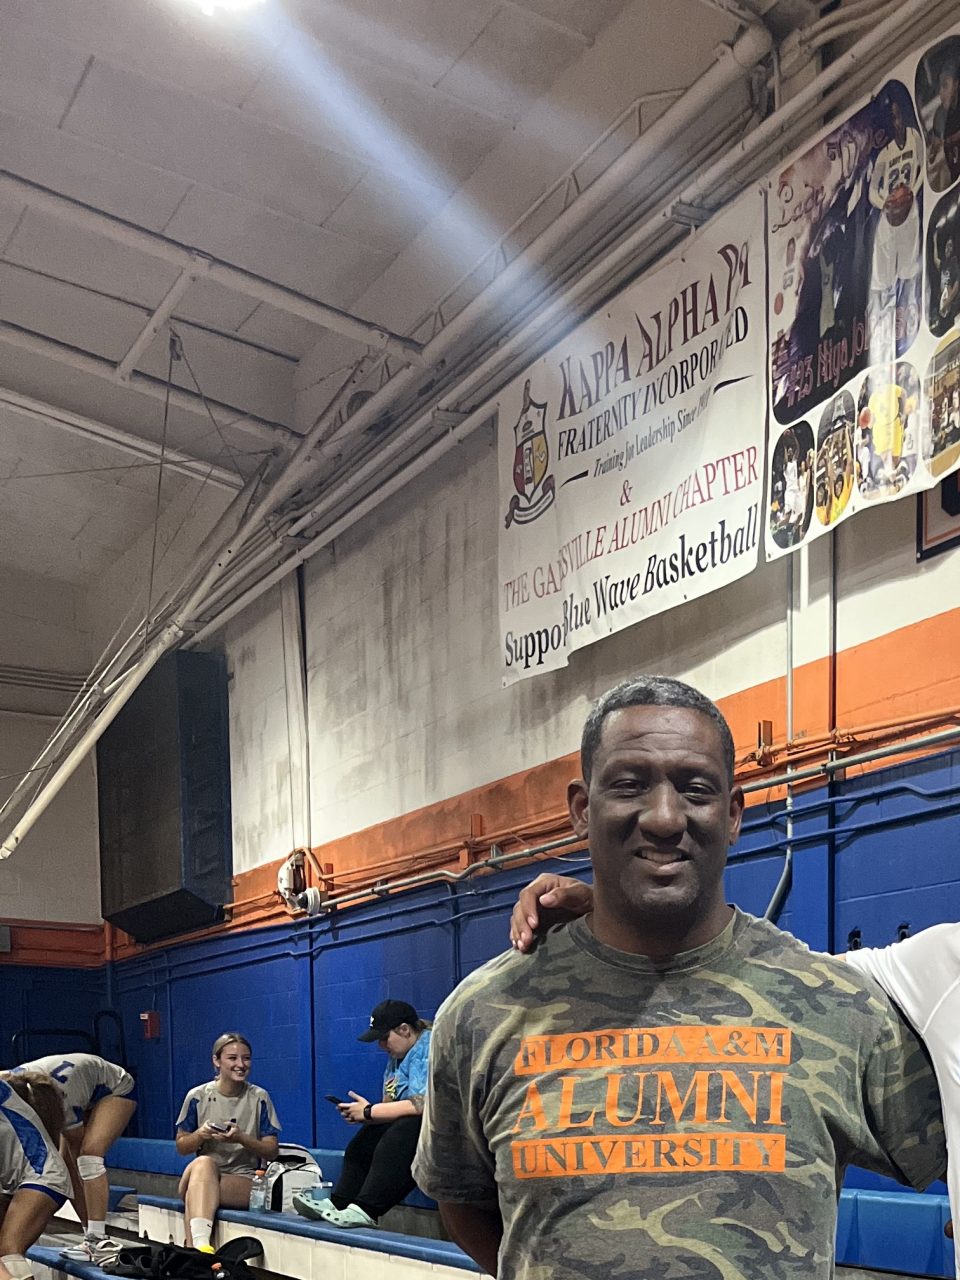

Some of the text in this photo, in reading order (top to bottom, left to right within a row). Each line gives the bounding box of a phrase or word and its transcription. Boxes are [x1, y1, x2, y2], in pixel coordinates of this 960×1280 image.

[556, 333, 631, 421] KAPPA
[635, 272, 720, 378] ALPHA
[557, 305, 749, 462] FRATERNITY INCORPORED
[593, 448, 624, 478] Training
[623, 440, 635, 469] for
[635, 416, 677, 456] Leadership
[677, 404, 698, 433] Since
[504, 571, 530, 613] THE
[607, 490, 673, 555] ALUMNI
[673, 446, 760, 520] CHAPTER
[619, 479, 634, 507] &
[593, 570, 641, 619] Wave
[641, 502, 759, 597] Basketball
[520, 1029, 785, 1068] FLORIDA A&M
[512, 1069, 789, 1133] ALUMNI
[518, 1138, 778, 1174] UNIVERSITY
